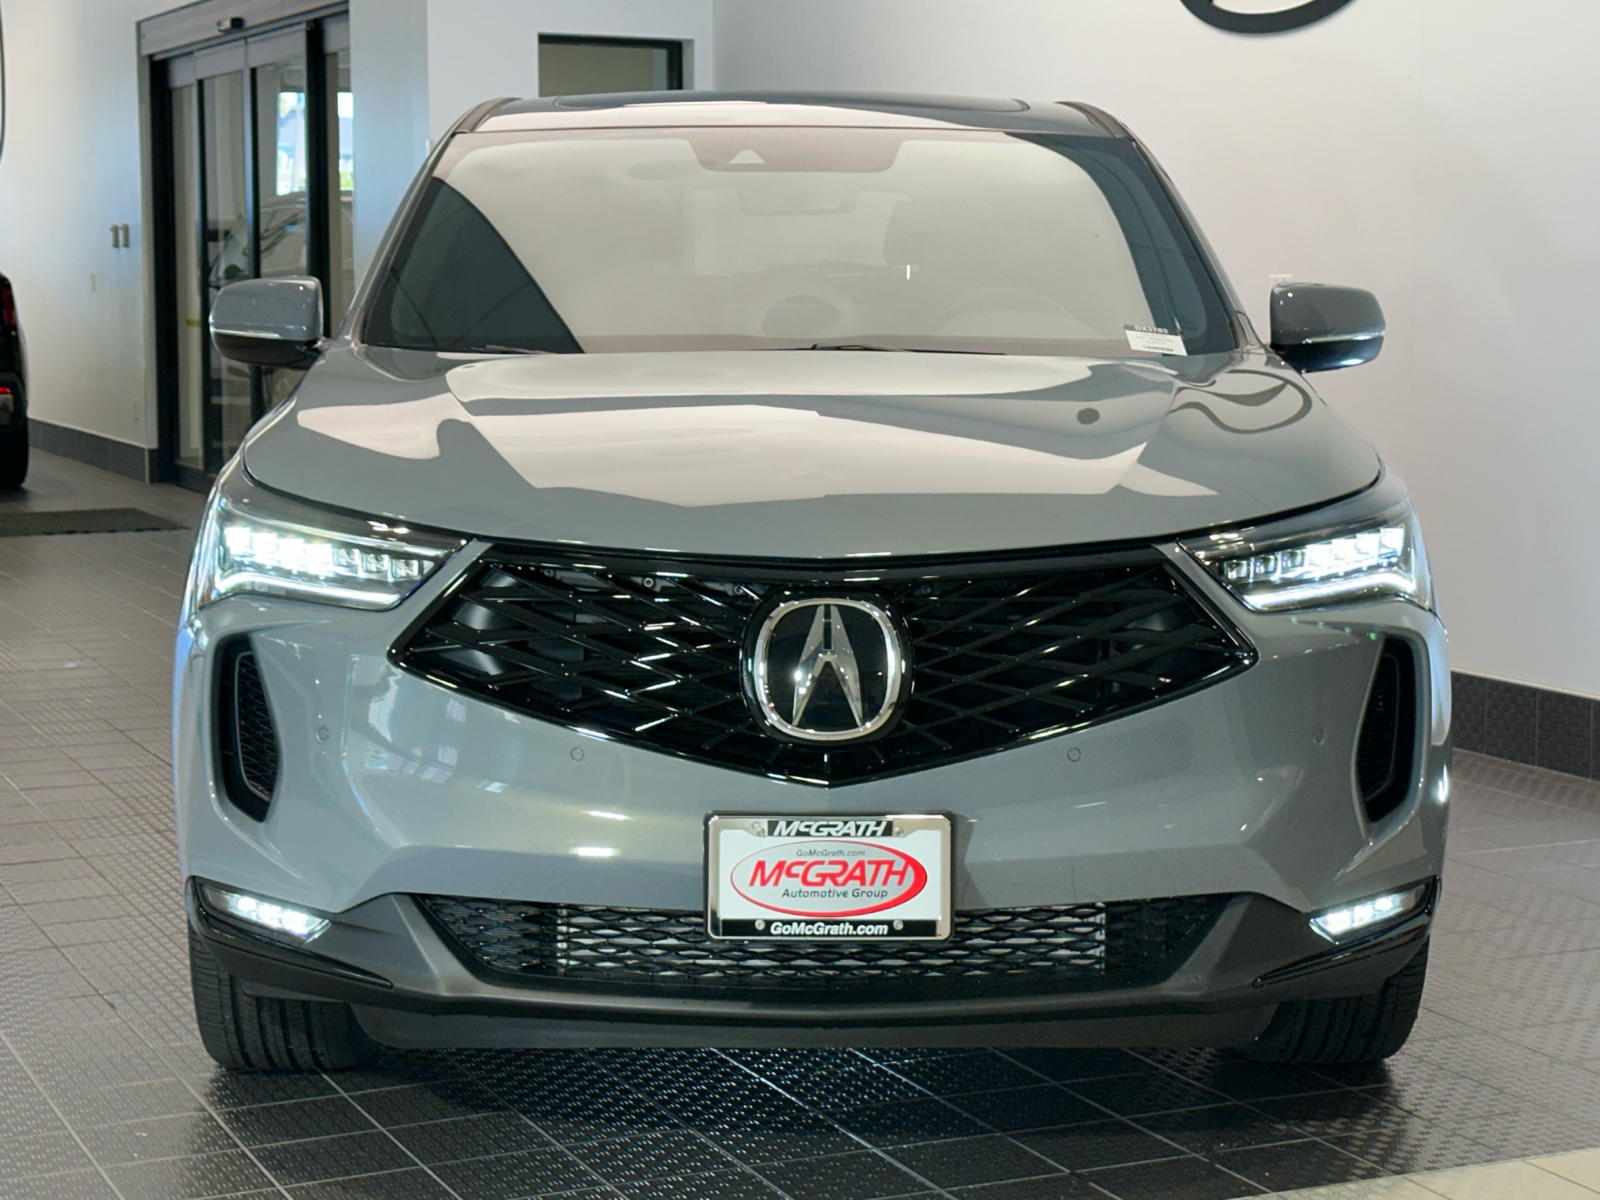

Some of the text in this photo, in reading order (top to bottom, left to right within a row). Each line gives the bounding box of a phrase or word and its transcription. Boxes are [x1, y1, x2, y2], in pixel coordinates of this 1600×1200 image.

[796, 849, 865, 857] GoMcGrath.com
[781, 888, 888, 899] Automotive Group
[770, 921, 888, 936] GoMcGrath.com
